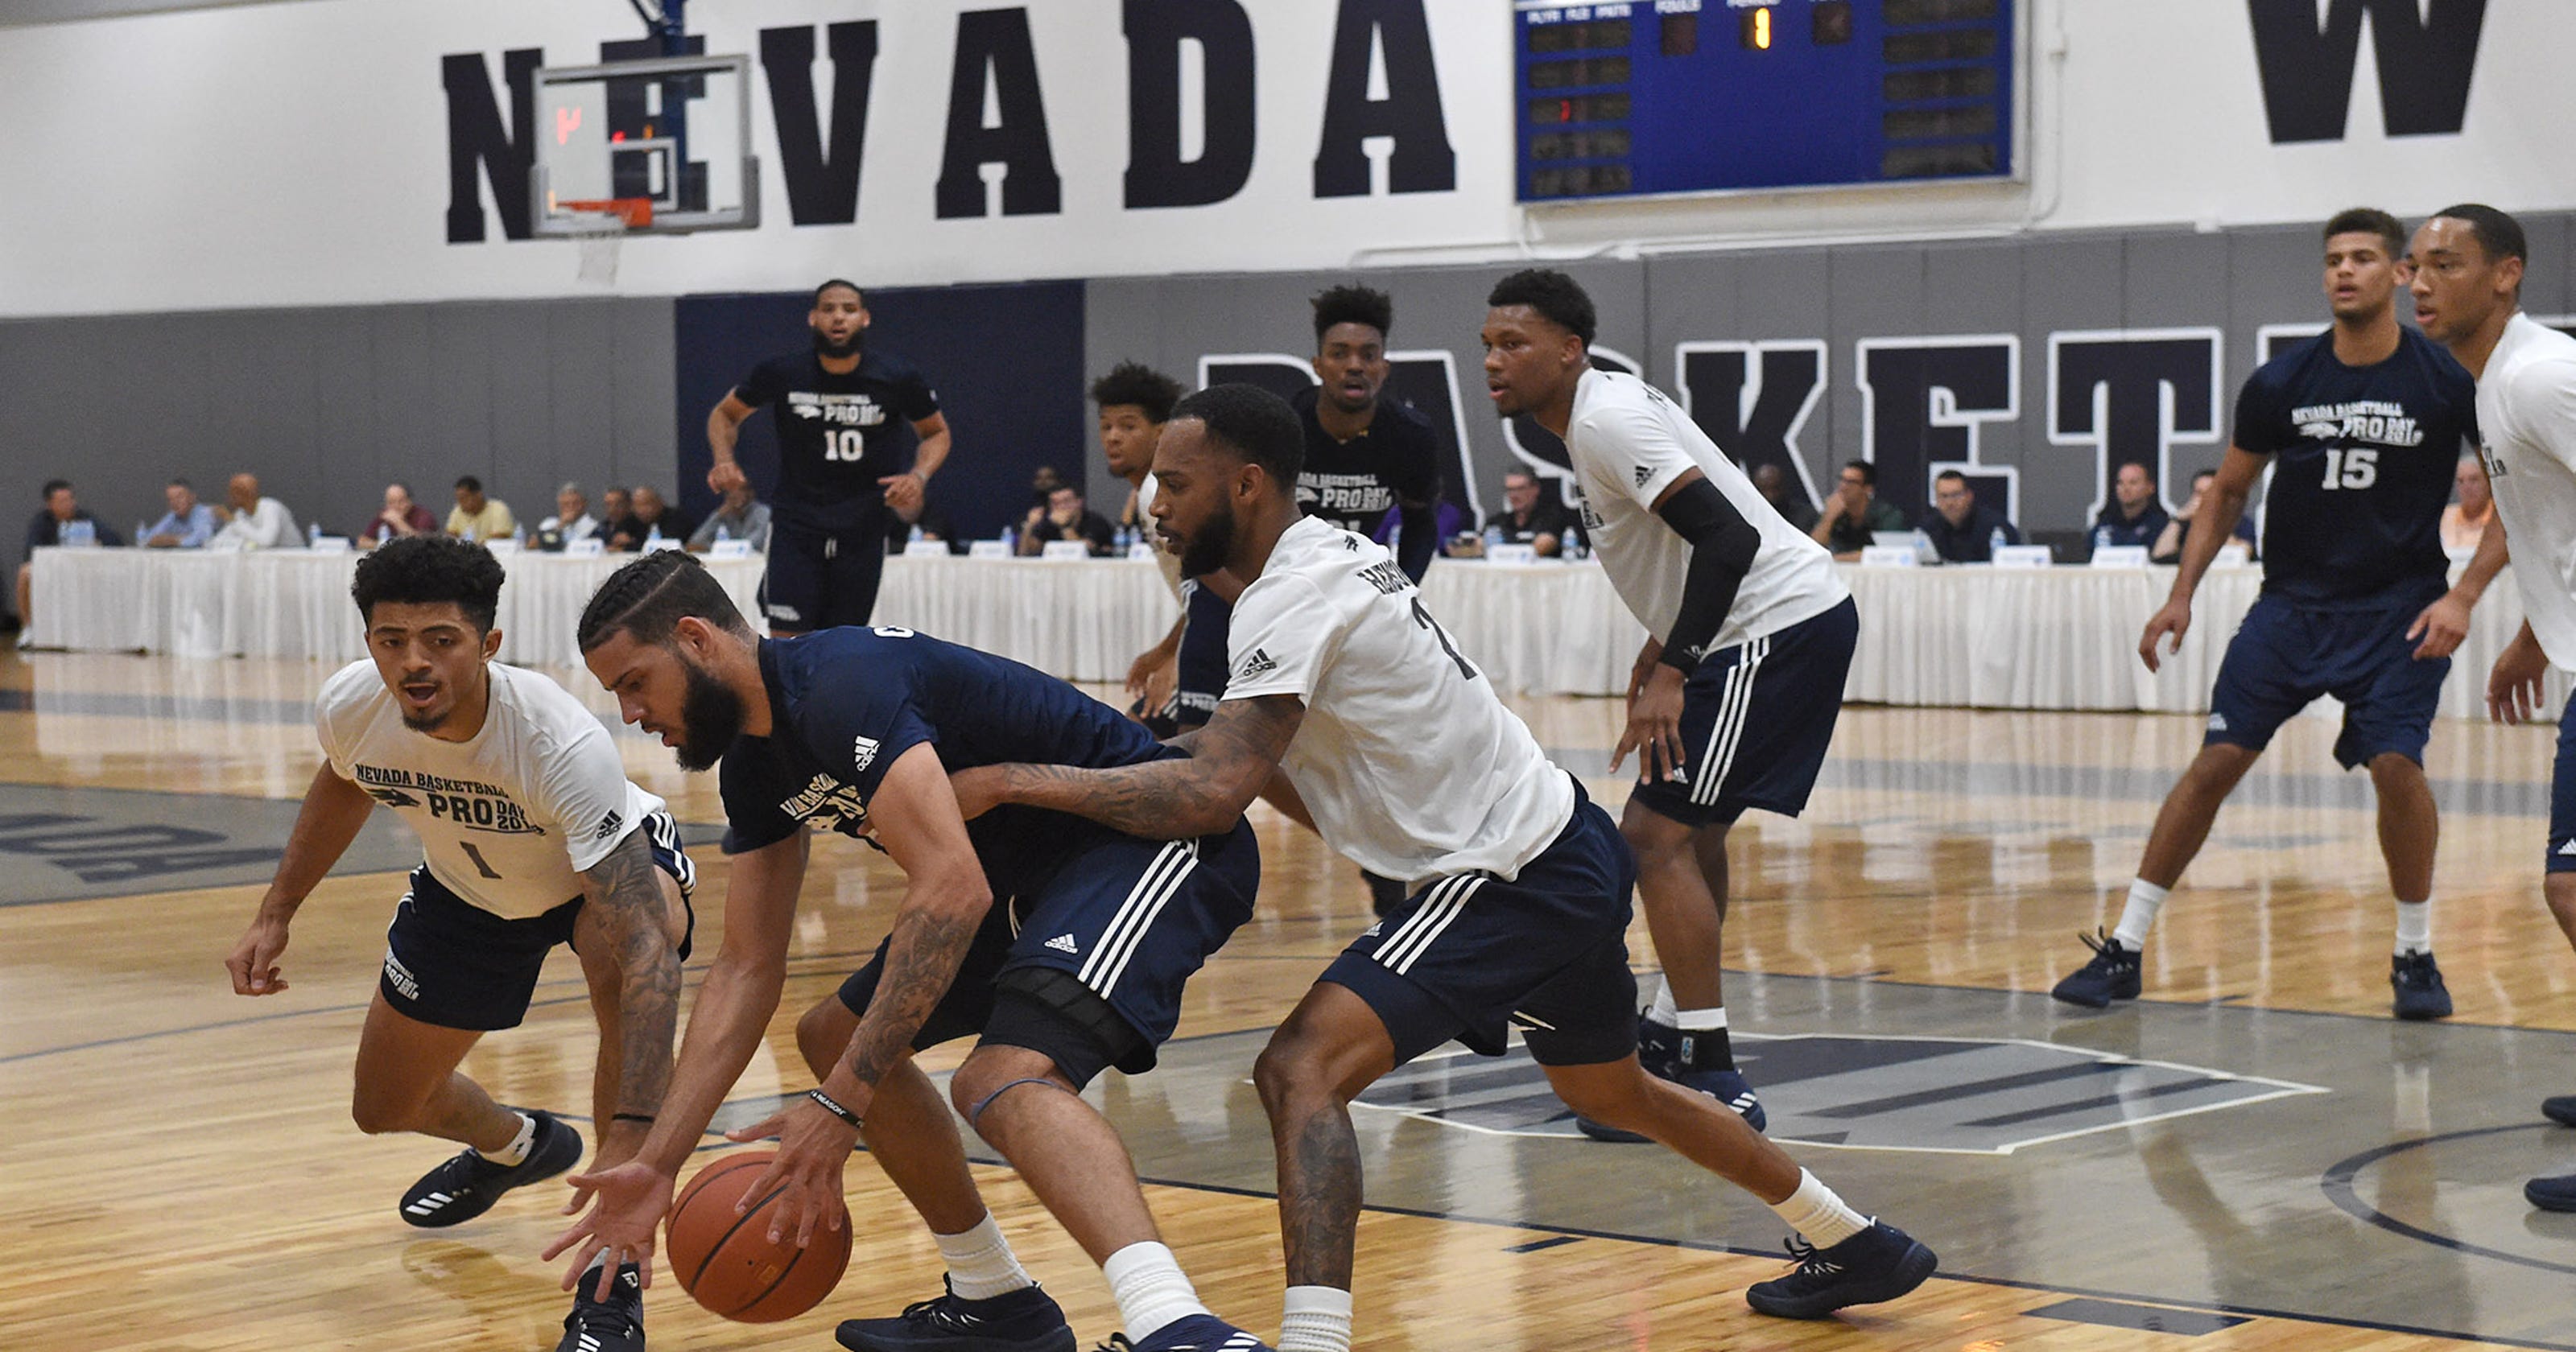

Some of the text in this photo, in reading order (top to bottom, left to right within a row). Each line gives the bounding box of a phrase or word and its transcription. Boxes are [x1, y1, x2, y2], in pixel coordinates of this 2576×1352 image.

[1755, 7, 1770, 50] 1
[2245, 0, 2489, 145] W
[442, 0, 1457, 244] NEVADA
[825, 429, 863, 461] 10
[2339, 415, 2384, 439] PRO
[2322, 448, 2379, 490] 15
[1321, 488, 1363, 509] PRO
[355, 764, 510, 799] NEVADA BASKETBALL
[427, 793, 526, 826] PRO DAY
[459, 841, 502, 880] 1
